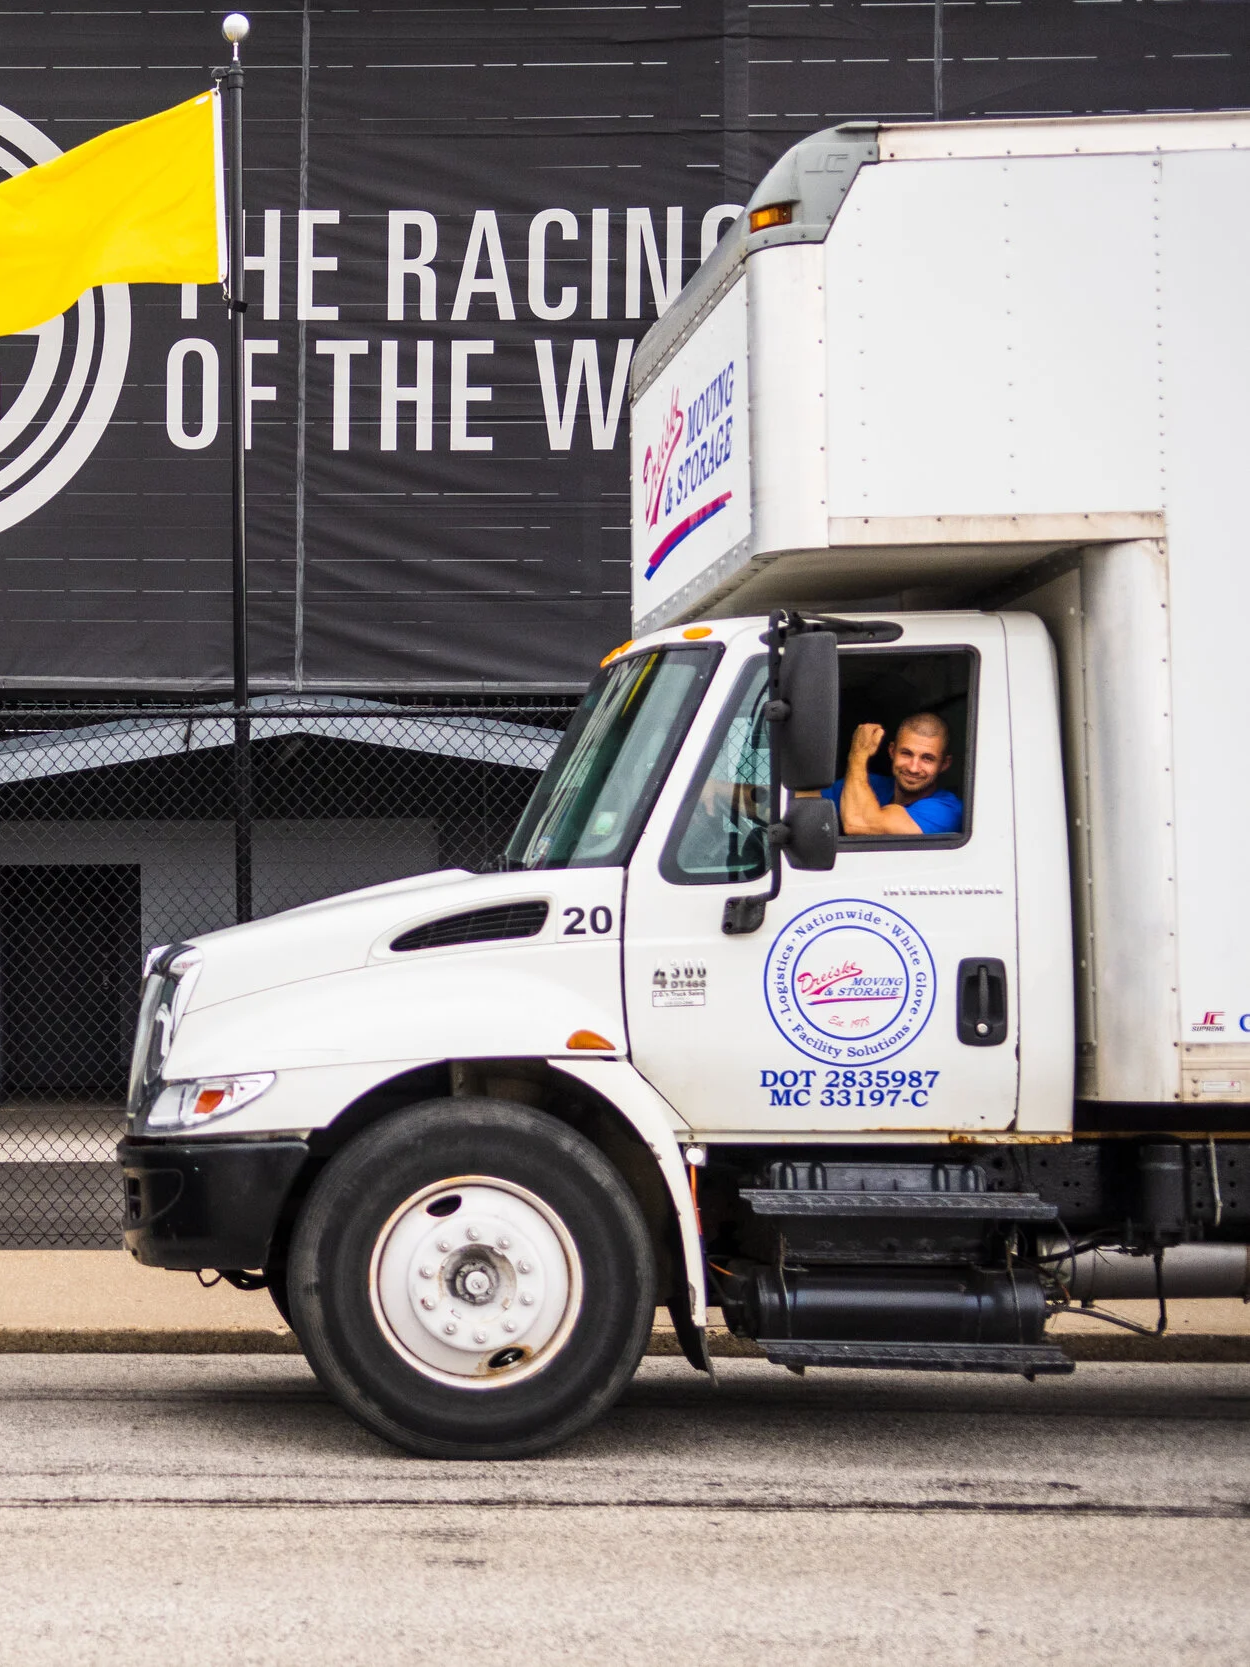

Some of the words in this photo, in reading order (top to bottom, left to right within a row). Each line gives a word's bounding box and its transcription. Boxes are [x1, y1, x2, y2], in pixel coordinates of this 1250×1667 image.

[181, 209, 340, 320] HE
[166, 338, 278, 450] OF
[316, 340, 493, 450] THE
[686, 360, 735, 448] MOVING
[665, 476, 674, 517] &
[676, 414, 734, 506] STORAGE
[562, 905, 613, 935] 20
[793, 909, 882, 939] Nationwide
[774, 944, 794, 1015] Logistics
[851, 977, 904, 987] MOVING
[891, 924, 921, 966] White
[909, 971, 927, 1016] Glove
[824, 987, 833, 997] &
[838, 987, 899, 997] STORAGE
[792, 1023, 842, 1059] Facility
[847, 1024, 910, 1058] Solutions
[760, 1070, 816, 1088] DOT
[825, 1070, 941, 1088] 2835987
[769, 1089, 811, 1107] MC
[820, 1089, 929, 1107] 33197-C
